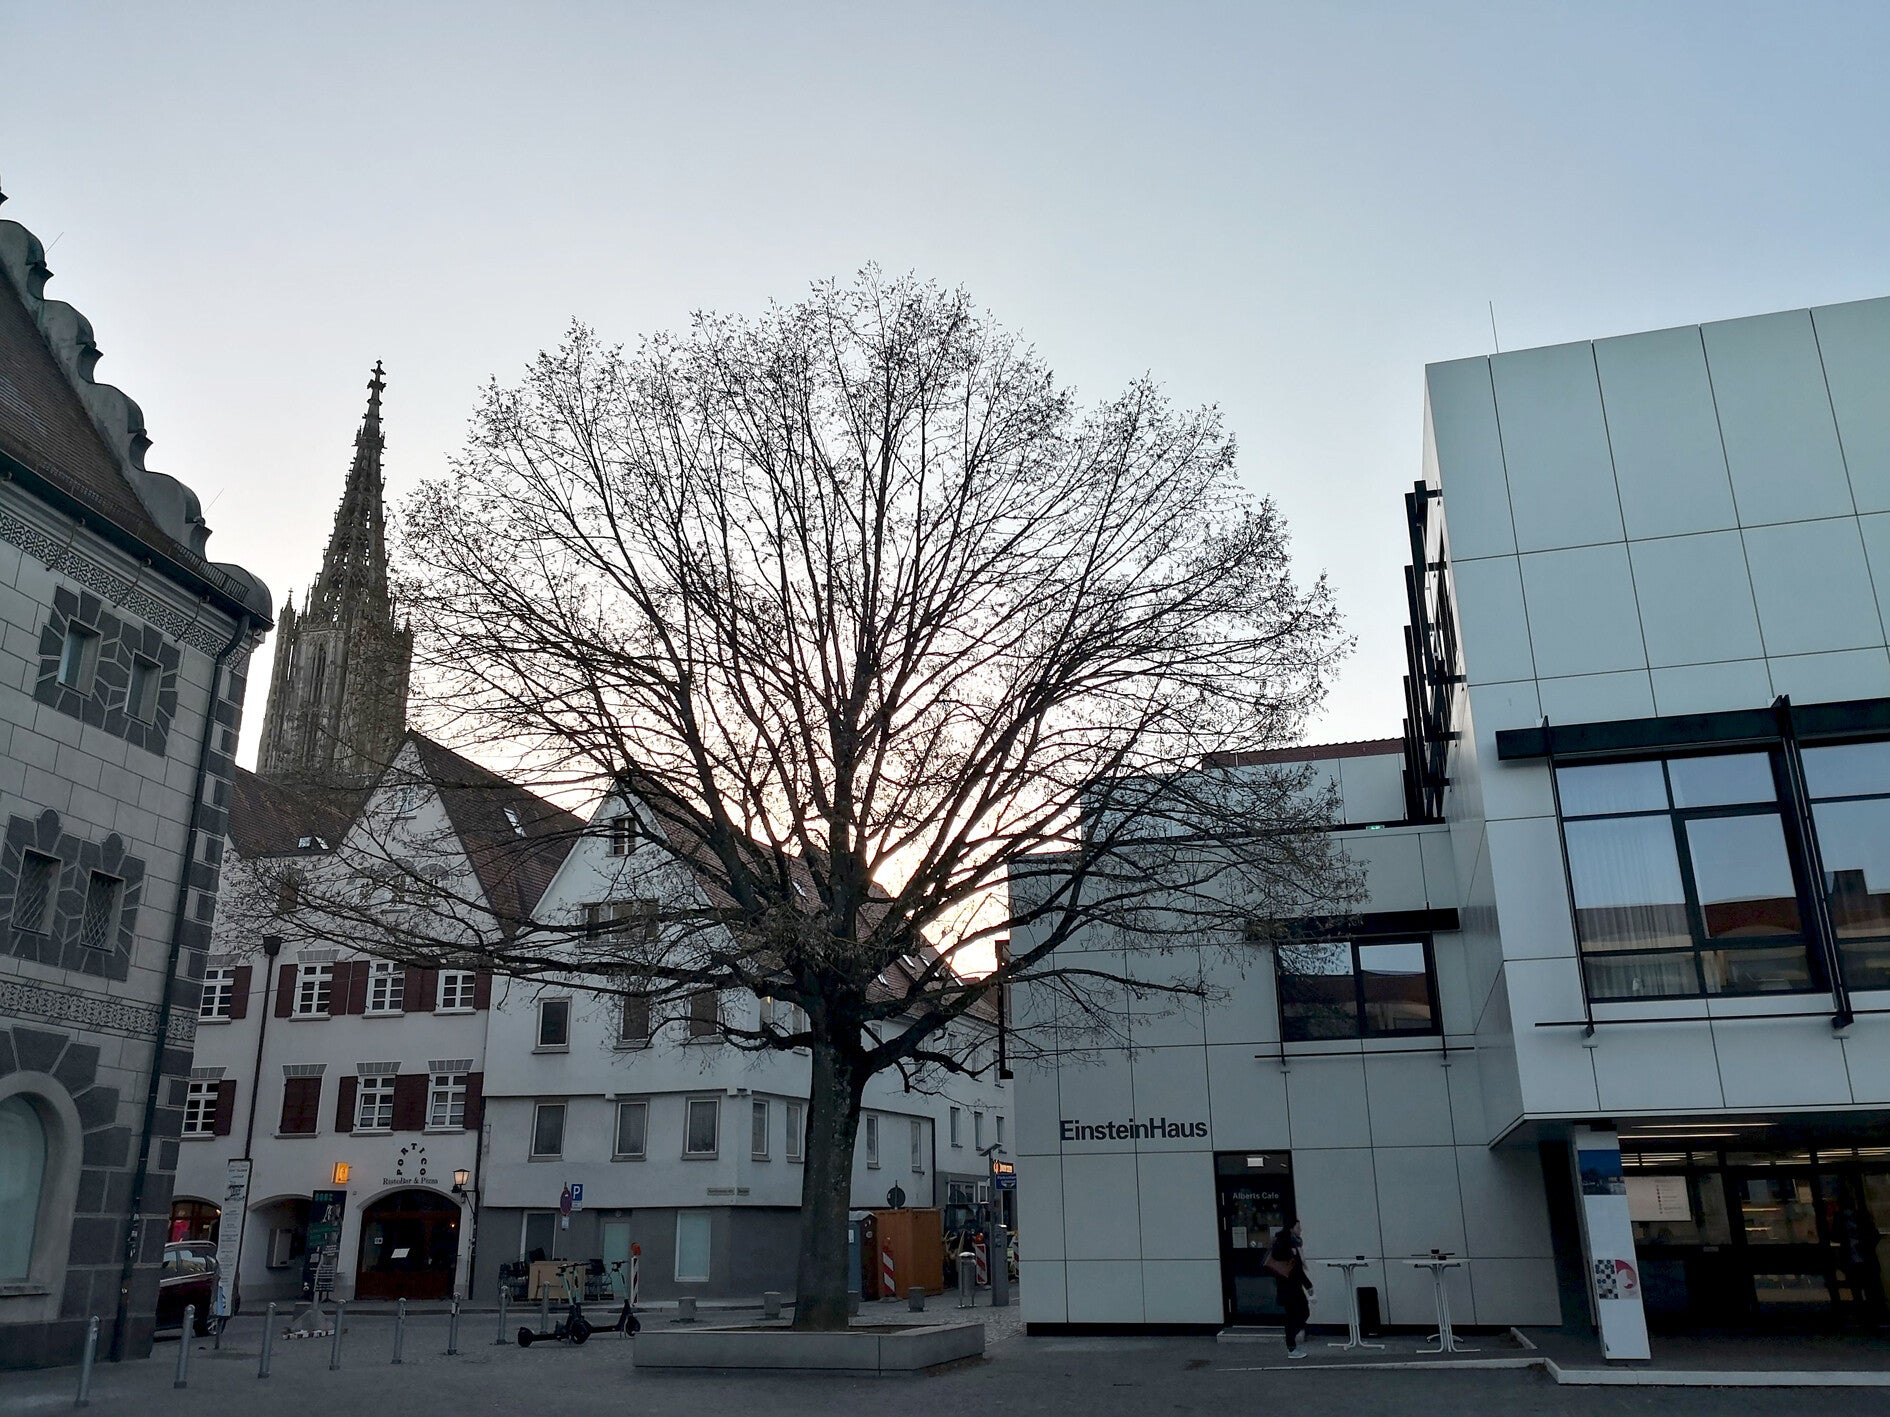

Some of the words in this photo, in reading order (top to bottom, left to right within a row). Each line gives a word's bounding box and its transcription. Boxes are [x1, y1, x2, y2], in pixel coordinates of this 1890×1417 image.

[1060, 1117, 1208, 1141] EinsteinHaus
[396, 1142, 427, 1176] PORTICO
[573, 1186, 581, 1199] P
[1232, 1191, 1260, 1200] Alberts
